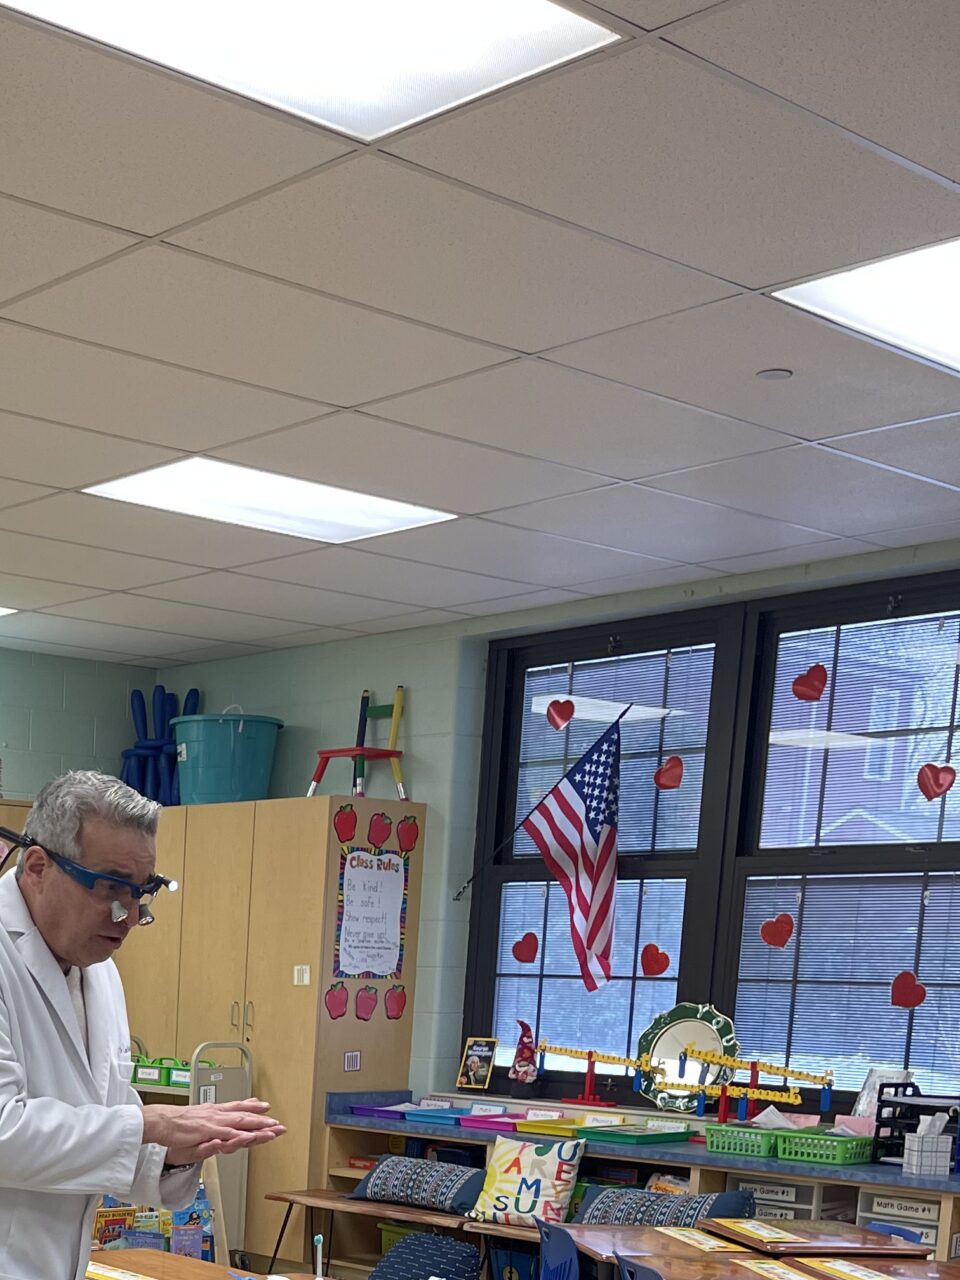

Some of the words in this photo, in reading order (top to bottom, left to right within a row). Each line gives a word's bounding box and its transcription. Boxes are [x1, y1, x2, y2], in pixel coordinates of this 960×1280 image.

[350, 855, 373, 869] Class
[377, 859, 399, 872] Rules
[347, 879, 356, 890] Be
[363, 881, 383, 892] kind!
[346, 895, 353, 905] Be
[345, 910, 359, 921] Show
[345, 926, 361, 937] Never
[503, 1157, 576, 1183] ARE
[760, 1187, 779, 1196] Game
[877, 1201, 894, 1209] Math
[897, 1203, 919, 1212] Game
[758, 1209, 777, 1217] Game
